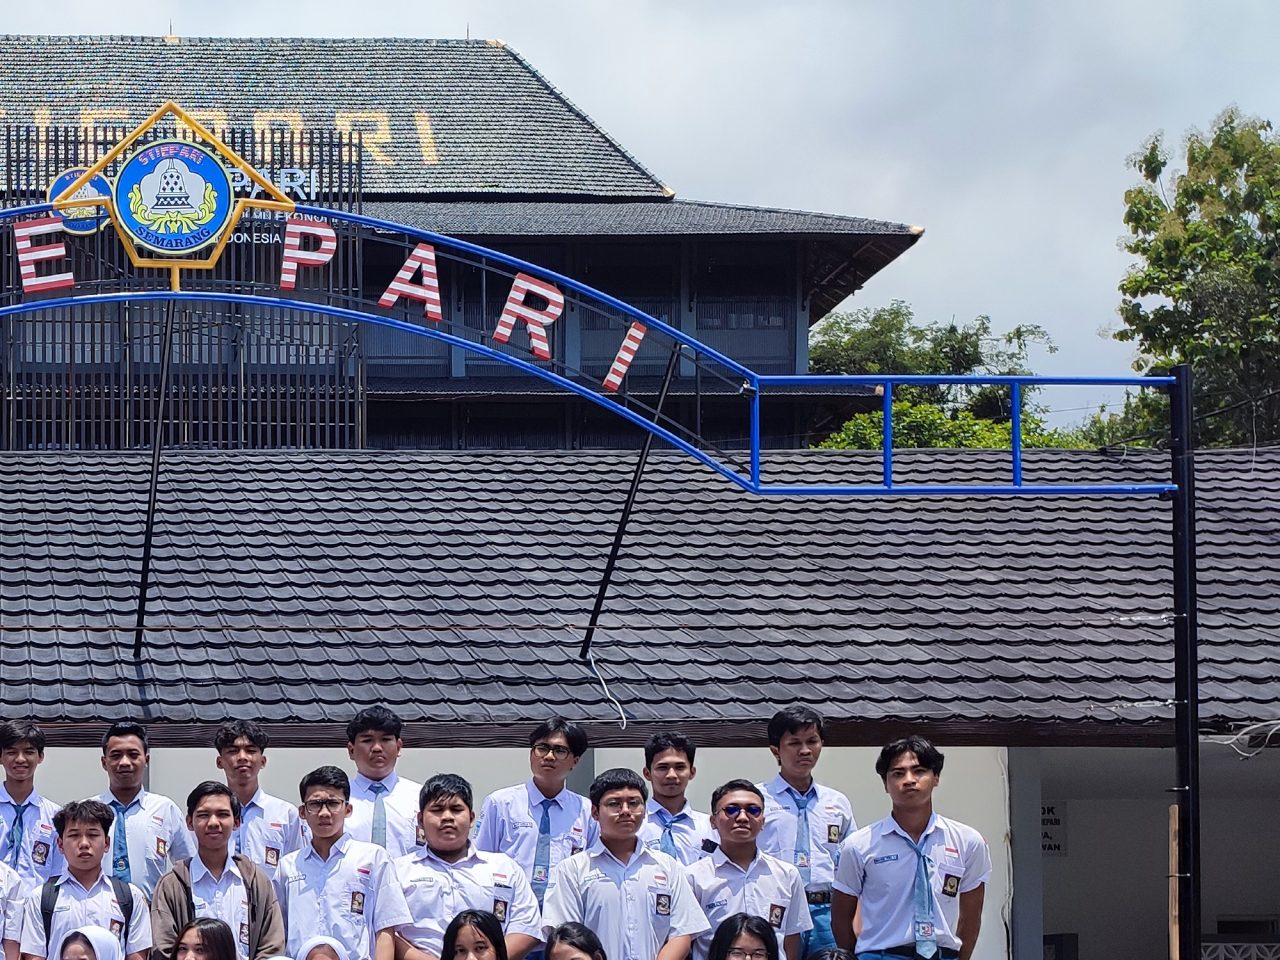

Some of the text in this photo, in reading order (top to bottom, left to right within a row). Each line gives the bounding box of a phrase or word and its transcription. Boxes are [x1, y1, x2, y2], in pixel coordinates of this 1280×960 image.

[138, 144, 206, 166] STIEPARI
[135, 226, 212, 248] SEMARANG
[279, 217, 648, 392] PARI
